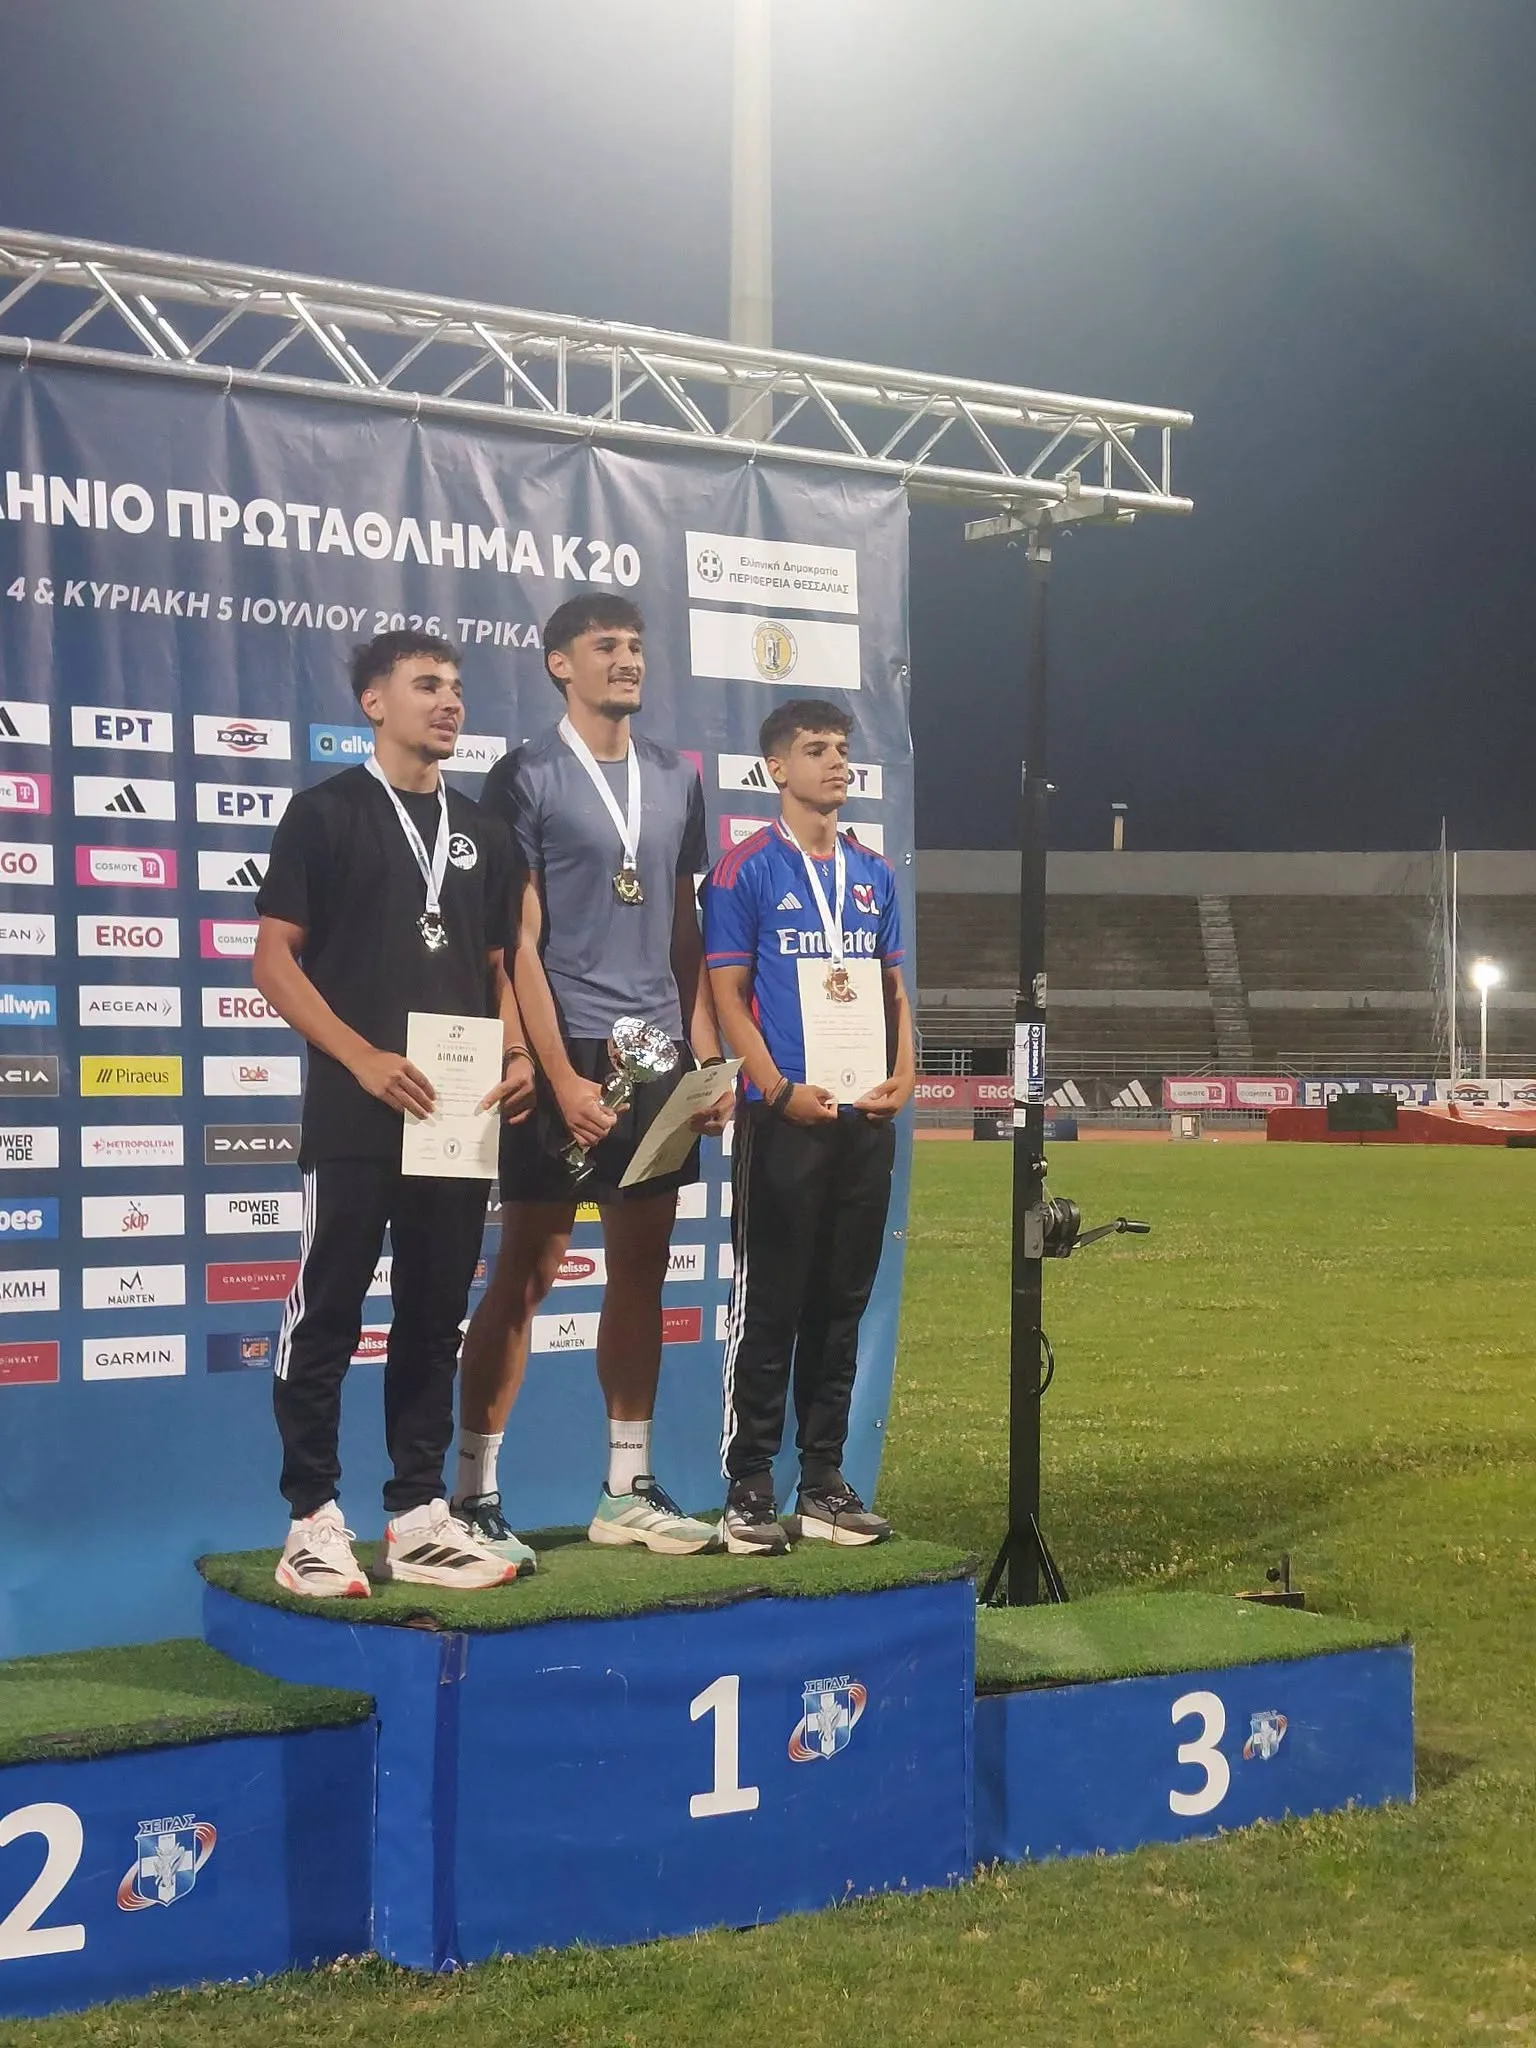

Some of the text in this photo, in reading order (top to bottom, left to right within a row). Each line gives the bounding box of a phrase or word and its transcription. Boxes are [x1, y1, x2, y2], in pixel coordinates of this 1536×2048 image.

[166, 489, 544, 576] ΠΡΩΤΑΘΛΗΜΑ
[552, 534, 641, 587] Κ20
[740, 556, 838, 577] Ελληνική Δημοκρατία
[729, 573, 849, 595] ΠΕΡΙΦΕΡΕΙΑ ΘΕΣΣΑΛΙΑΣ
[7, 576, 26, 601] 4
[34, 578, 54, 605] &
[63, 580, 210, 619] ΚΥΡΙΑΚΗ
[217, 597, 234, 621] 5
[242, 600, 368, 633] ΙΟΥΛΙΟΥ
[457, 618, 546, 650] ΤΡΙΚΑ
[95, 714, 153, 743] ΕΡΤ
[340, 735, 375, 754] allw
[217, 791, 274, 818] ΕΡΤ
[0, 852, 37, 874] GO
[95, 862, 138, 872] COSMOTE
[96, 925, 163, 948] ERGO
[89, 1001, 158, 1012] AEGEAN
[116, 1067, 169, 1083] Piraeus
[239, 1065, 269, 1080] Dole
[914, 1084, 955, 1099] ERGO
[0, 1134, 33, 1147] WER
[106, 1139, 174, 1149] METROPOLITAN
[214, 1138, 293, 1150] DACIA
[6, 1148, 33, 1161] ADE
[229, 1200, 279, 1213] POWER
[252, 1213, 279, 1225] ADE
[222, 1274, 287, 1284] GRAND HYATT
[0, 1281, 46, 1299] ΚΜΗ
[108, 1294, 155, 1305] MAURTEN
[358, 1337, 388, 1350] eliss
[549, 1339, 585, 1349] MAURTEN
[8, 1356, 39, 1364] HYATT
[96, 1350, 171, 1367] GARMIN
[803, 1675, 850, 1694] ΣΕΓΑΣ
[690, 1674, 759, 1818] 1
[1169, 1691, 1230, 1816] 3
[137, 1813, 197, 1837] ΣΕΓΑΣ
[0, 1802, 85, 1961] 2
